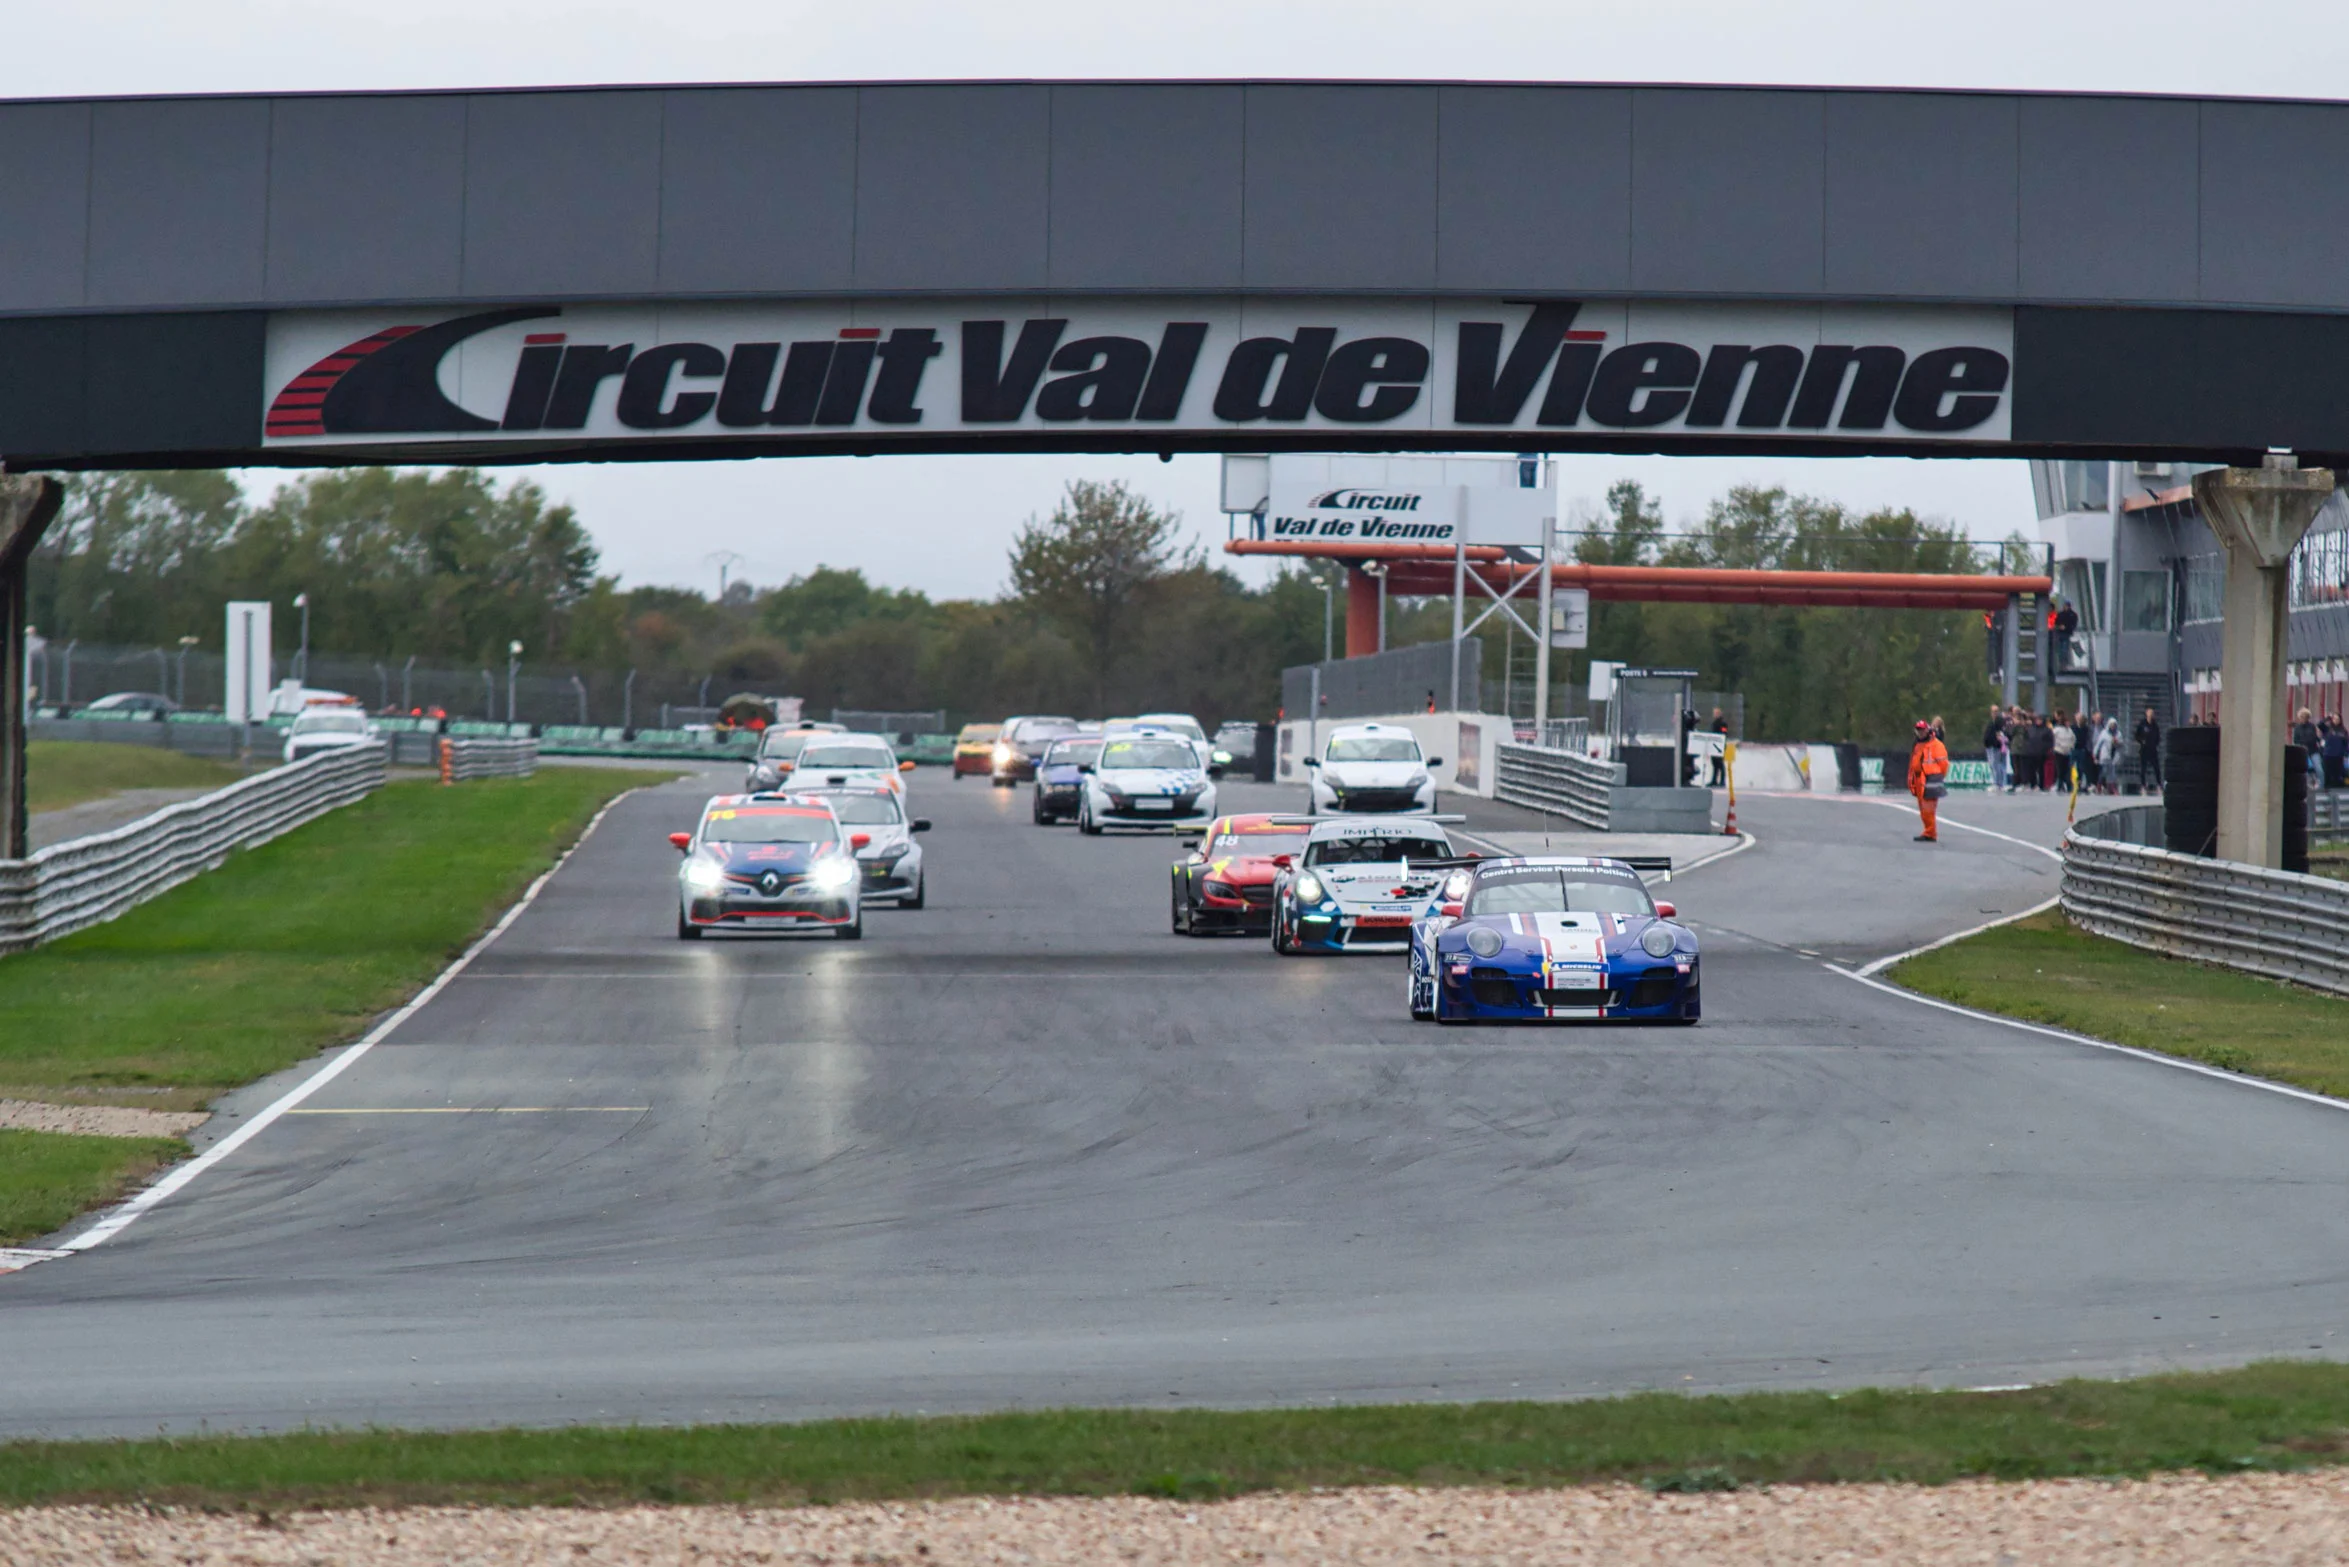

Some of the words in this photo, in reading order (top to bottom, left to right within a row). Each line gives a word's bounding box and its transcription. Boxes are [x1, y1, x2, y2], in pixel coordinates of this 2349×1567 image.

[265, 305, 943, 434] Circuit
[961, 318, 1209, 424] Val
[1212, 325, 1431, 424] de
[1455, 300, 2010, 433] Vienne
[1308, 488, 1422, 511] Circuit
[1274, 517, 1318, 535] Val
[1319, 518, 1355, 537] de
[1360, 516, 1454, 538] Vienne
[1214, 834, 1240, 847] 48
[1481, 868, 1514, 879] Centre
[1516, 866, 1553, 874] Service
[1554, 865, 1595, 874] Porsche
[1596, 867, 1635, 879] Poitiers
